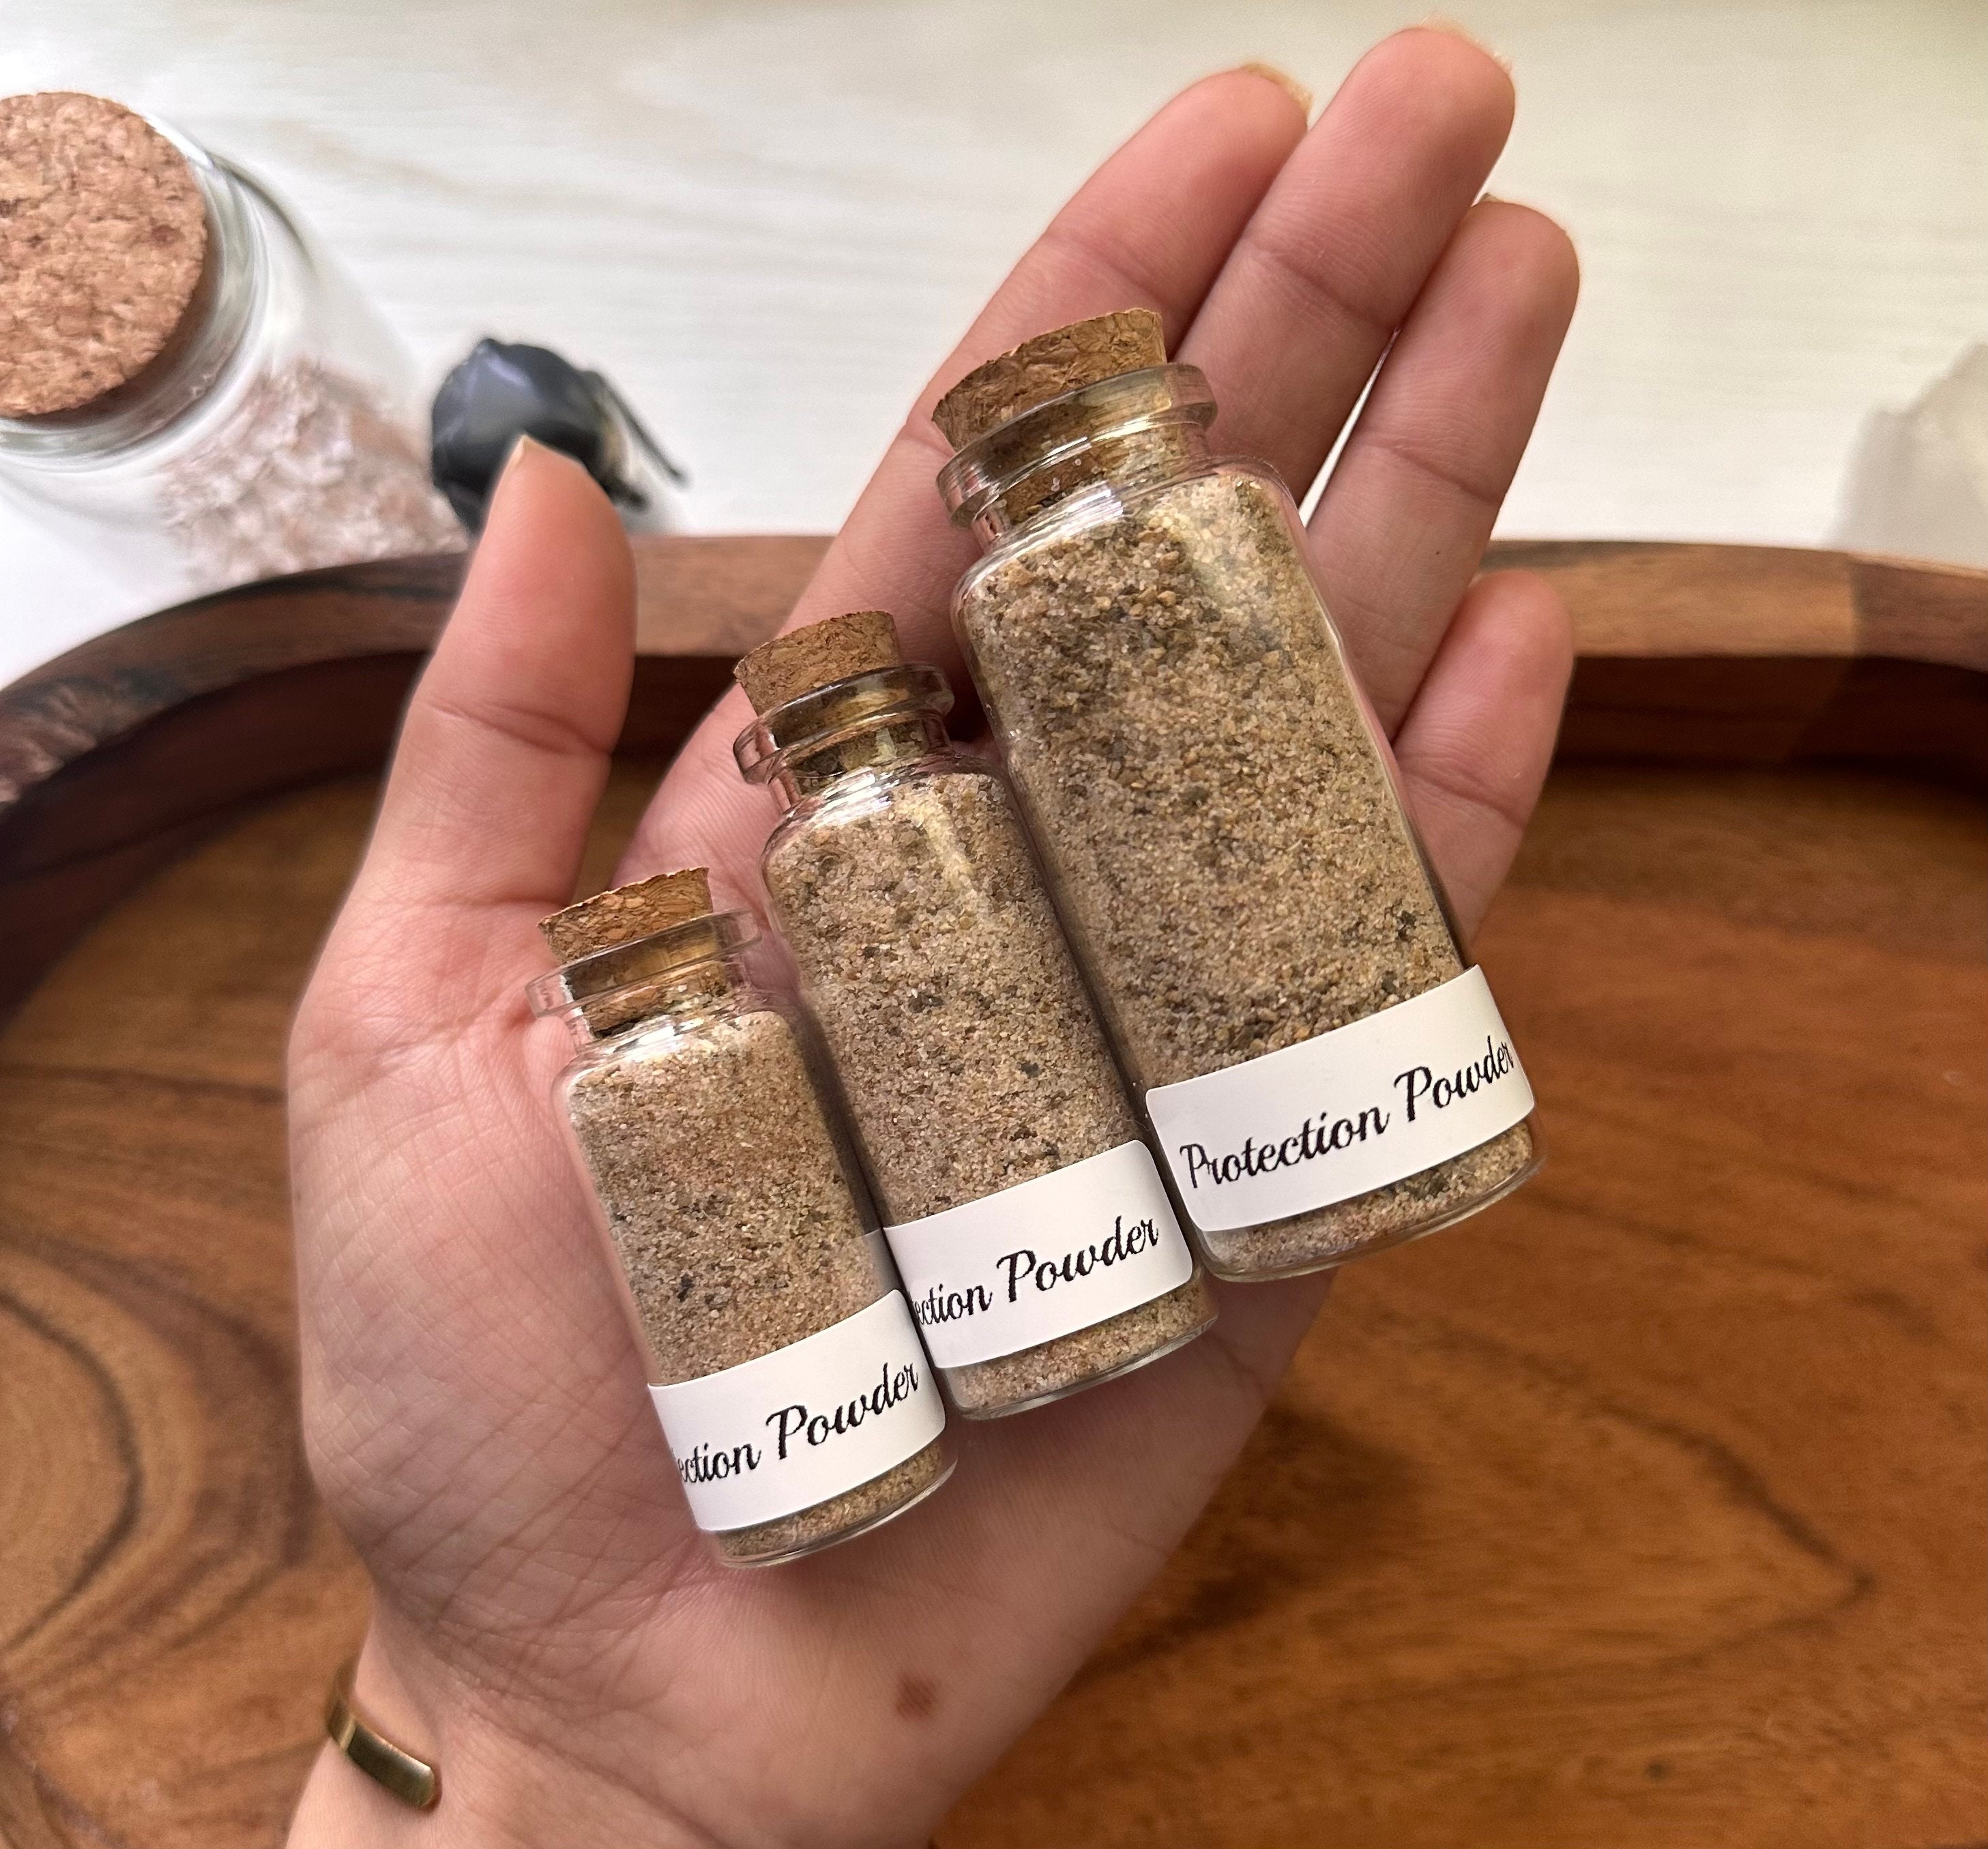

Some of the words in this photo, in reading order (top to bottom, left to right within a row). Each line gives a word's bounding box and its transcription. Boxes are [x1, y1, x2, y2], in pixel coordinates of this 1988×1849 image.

[1180, 1111, 1390, 1189] Protection
[1394, 1034, 1515, 1122] Powder
[912, 1283, 993, 1326] ection
[997, 1215, 1159, 1303] Powder
[672, 1442, 761, 1484] ection
[766, 1362, 919, 1460] Powder
